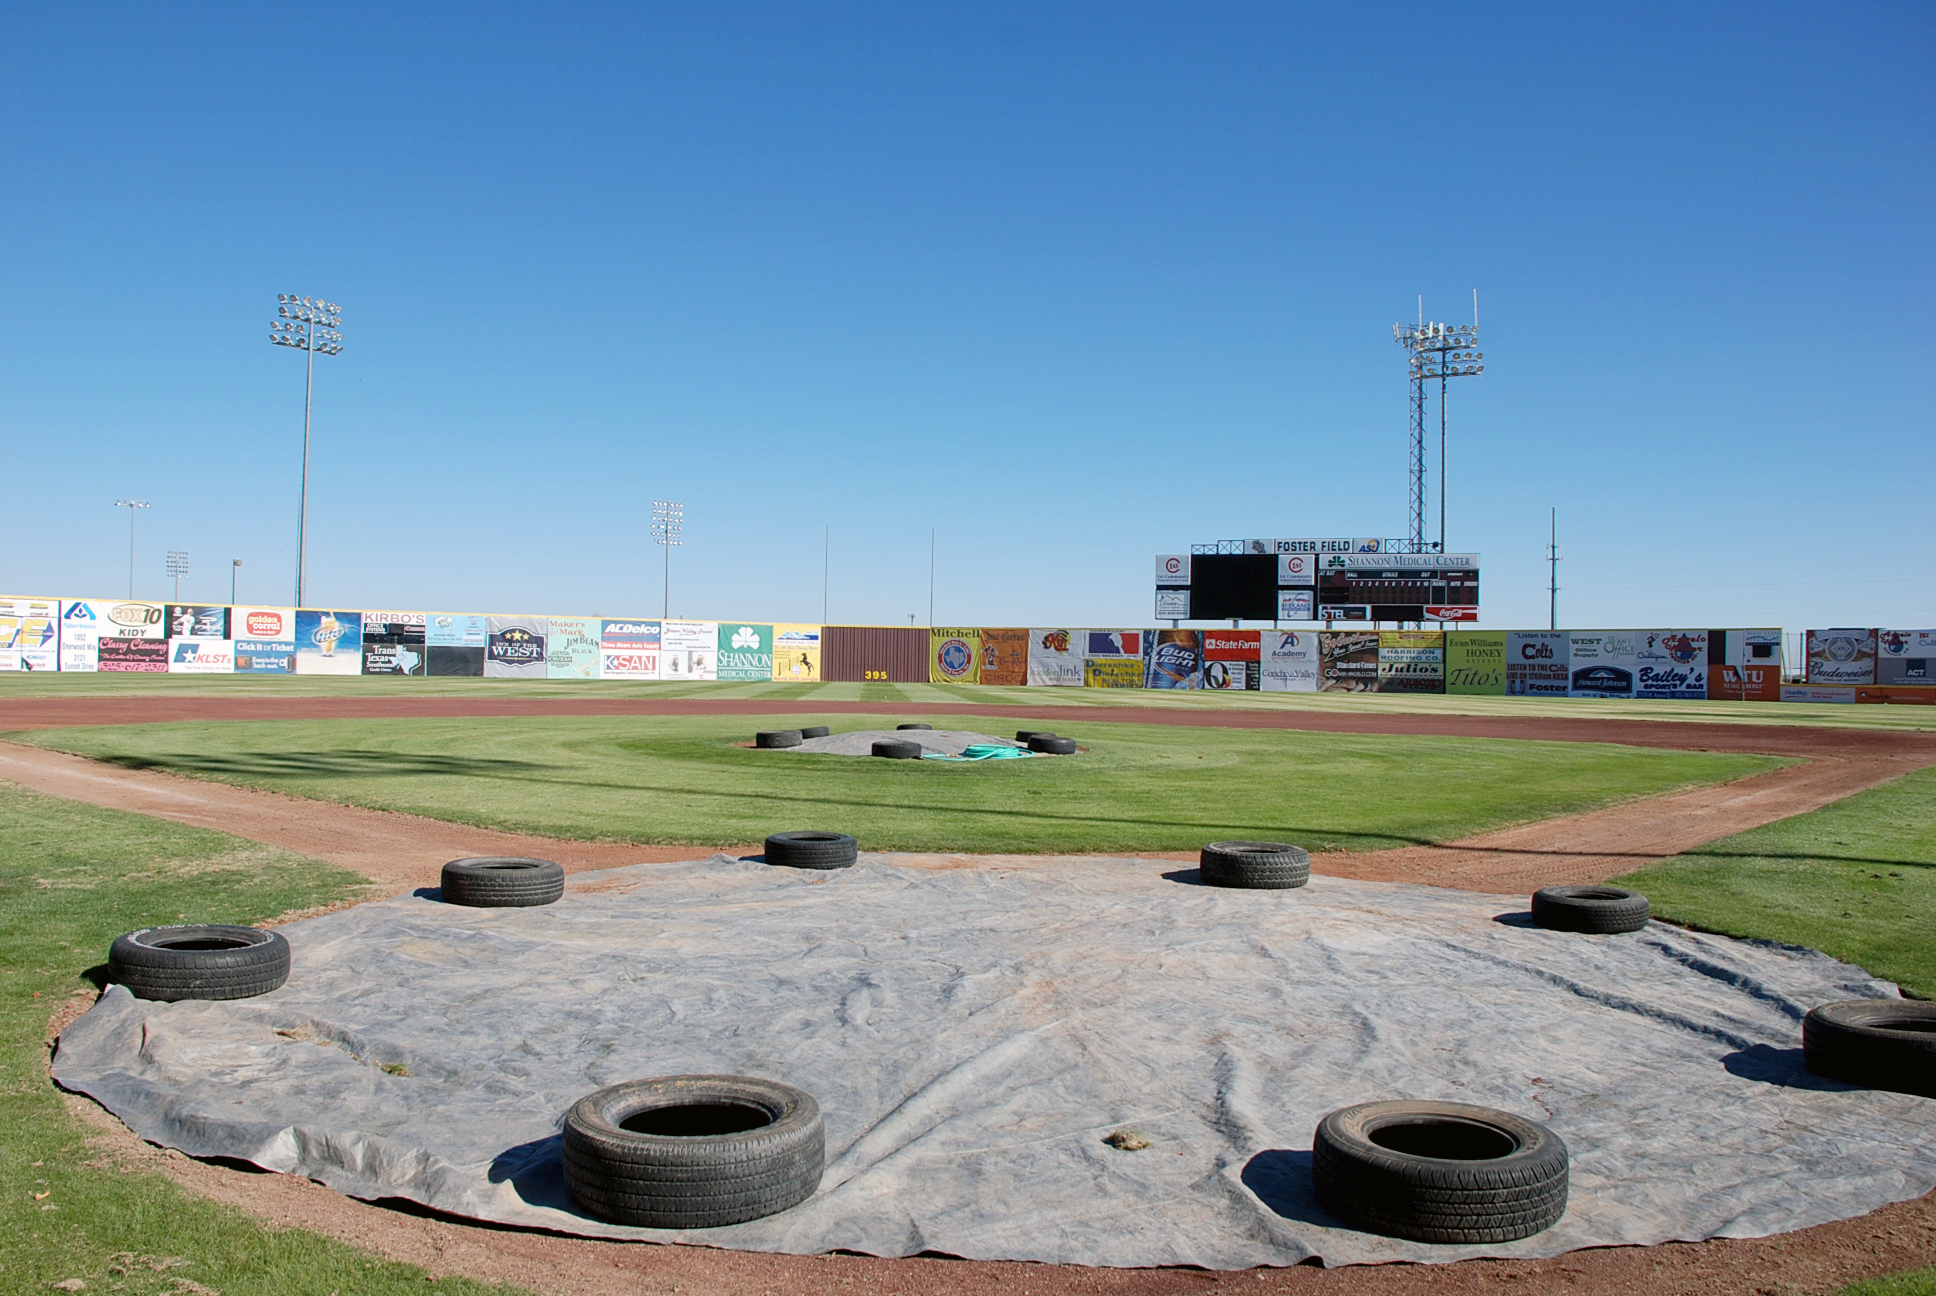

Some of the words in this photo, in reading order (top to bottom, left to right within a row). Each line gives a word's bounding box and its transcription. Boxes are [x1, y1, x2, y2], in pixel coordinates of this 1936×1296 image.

[1277, 541, 1316, 552] FOSTER
[1321, 541, 1350, 552] FIELD
[1348, 556, 1390, 566] SHANNON
[1394, 556, 1433, 566] MEDICAL
[1436, 555, 1470, 566] CENTER
[248, 615, 279, 625] golden
[364, 612, 425, 624] KIRBO'S
[63, 621, 97, 630] Albertsons
[252, 622, 282, 631] corral
[549, 620, 586, 628] Maker's
[604, 623, 660, 634] ACDelco
[118, 628, 148, 637] KIDY
[559, 628, 583, 637] Mark
[931, 629, 980, 638] Mitchell
[62, 642, 86, 651] Sherwood
[87, 643, 98, 652] Way
[100, 638, 129, 653] Classy
[130, 638, 168, 654] Cleaning
[237, 642, 256, 651] Click
[263, 644, 271, 652] or
[271, 643, 295, 652] Ticket
[564, 638, 579, 650] JIM
[579, 636, 600, 651] BEAM
[1449, 639, 1470, 647] Evan
[1470, 639, 1504, 647] Williams
[373, 645, 397, 655] Trans
[491, 647, 541, 657] WEST
[1159, 647, 1195, 660] BUD
[1272, 650, 1306, 660] Academy
[1466, 648, 1503, 658] HONEY
[1521, 642, 1555, 660] Colts
[73, 653, 87, 662] 3121
[366, 653, 390, 662] Texas
[718, 650, 772, 668] SHANNON
[1636, 651, 1668, 661] Culligan
[64, 662, 81, 671] Sunset
[82, 662, 95, 671] Drive
[1087, 659, 1136, 669] Dierschke
[1155, 655, 1196, 668] LIGHT
[1381, 663, 1439, 674] Julio's
[1537, 664, 1548, 672] THE
[1808, 660, 1873, 678] Budweiser
[1906, 669, 1925, 677] ACT
[719, 670, 746, 678] MEDICAL
[747, 670, 772, 679] CENTER
[864, 671, 888, 680] 395
[1262, 669, 1290, 678] Concho
[1293, 669, 1316, 679] Valley
[1450, 667, 1503, 686] Tito's
[1638, 666, 1705, 688] Bailey's
[1529, 684, 1568, 692] Foster
[1576, 679, 1601, 687] Howard
[1600, 679, 1627, 688] Johnson
